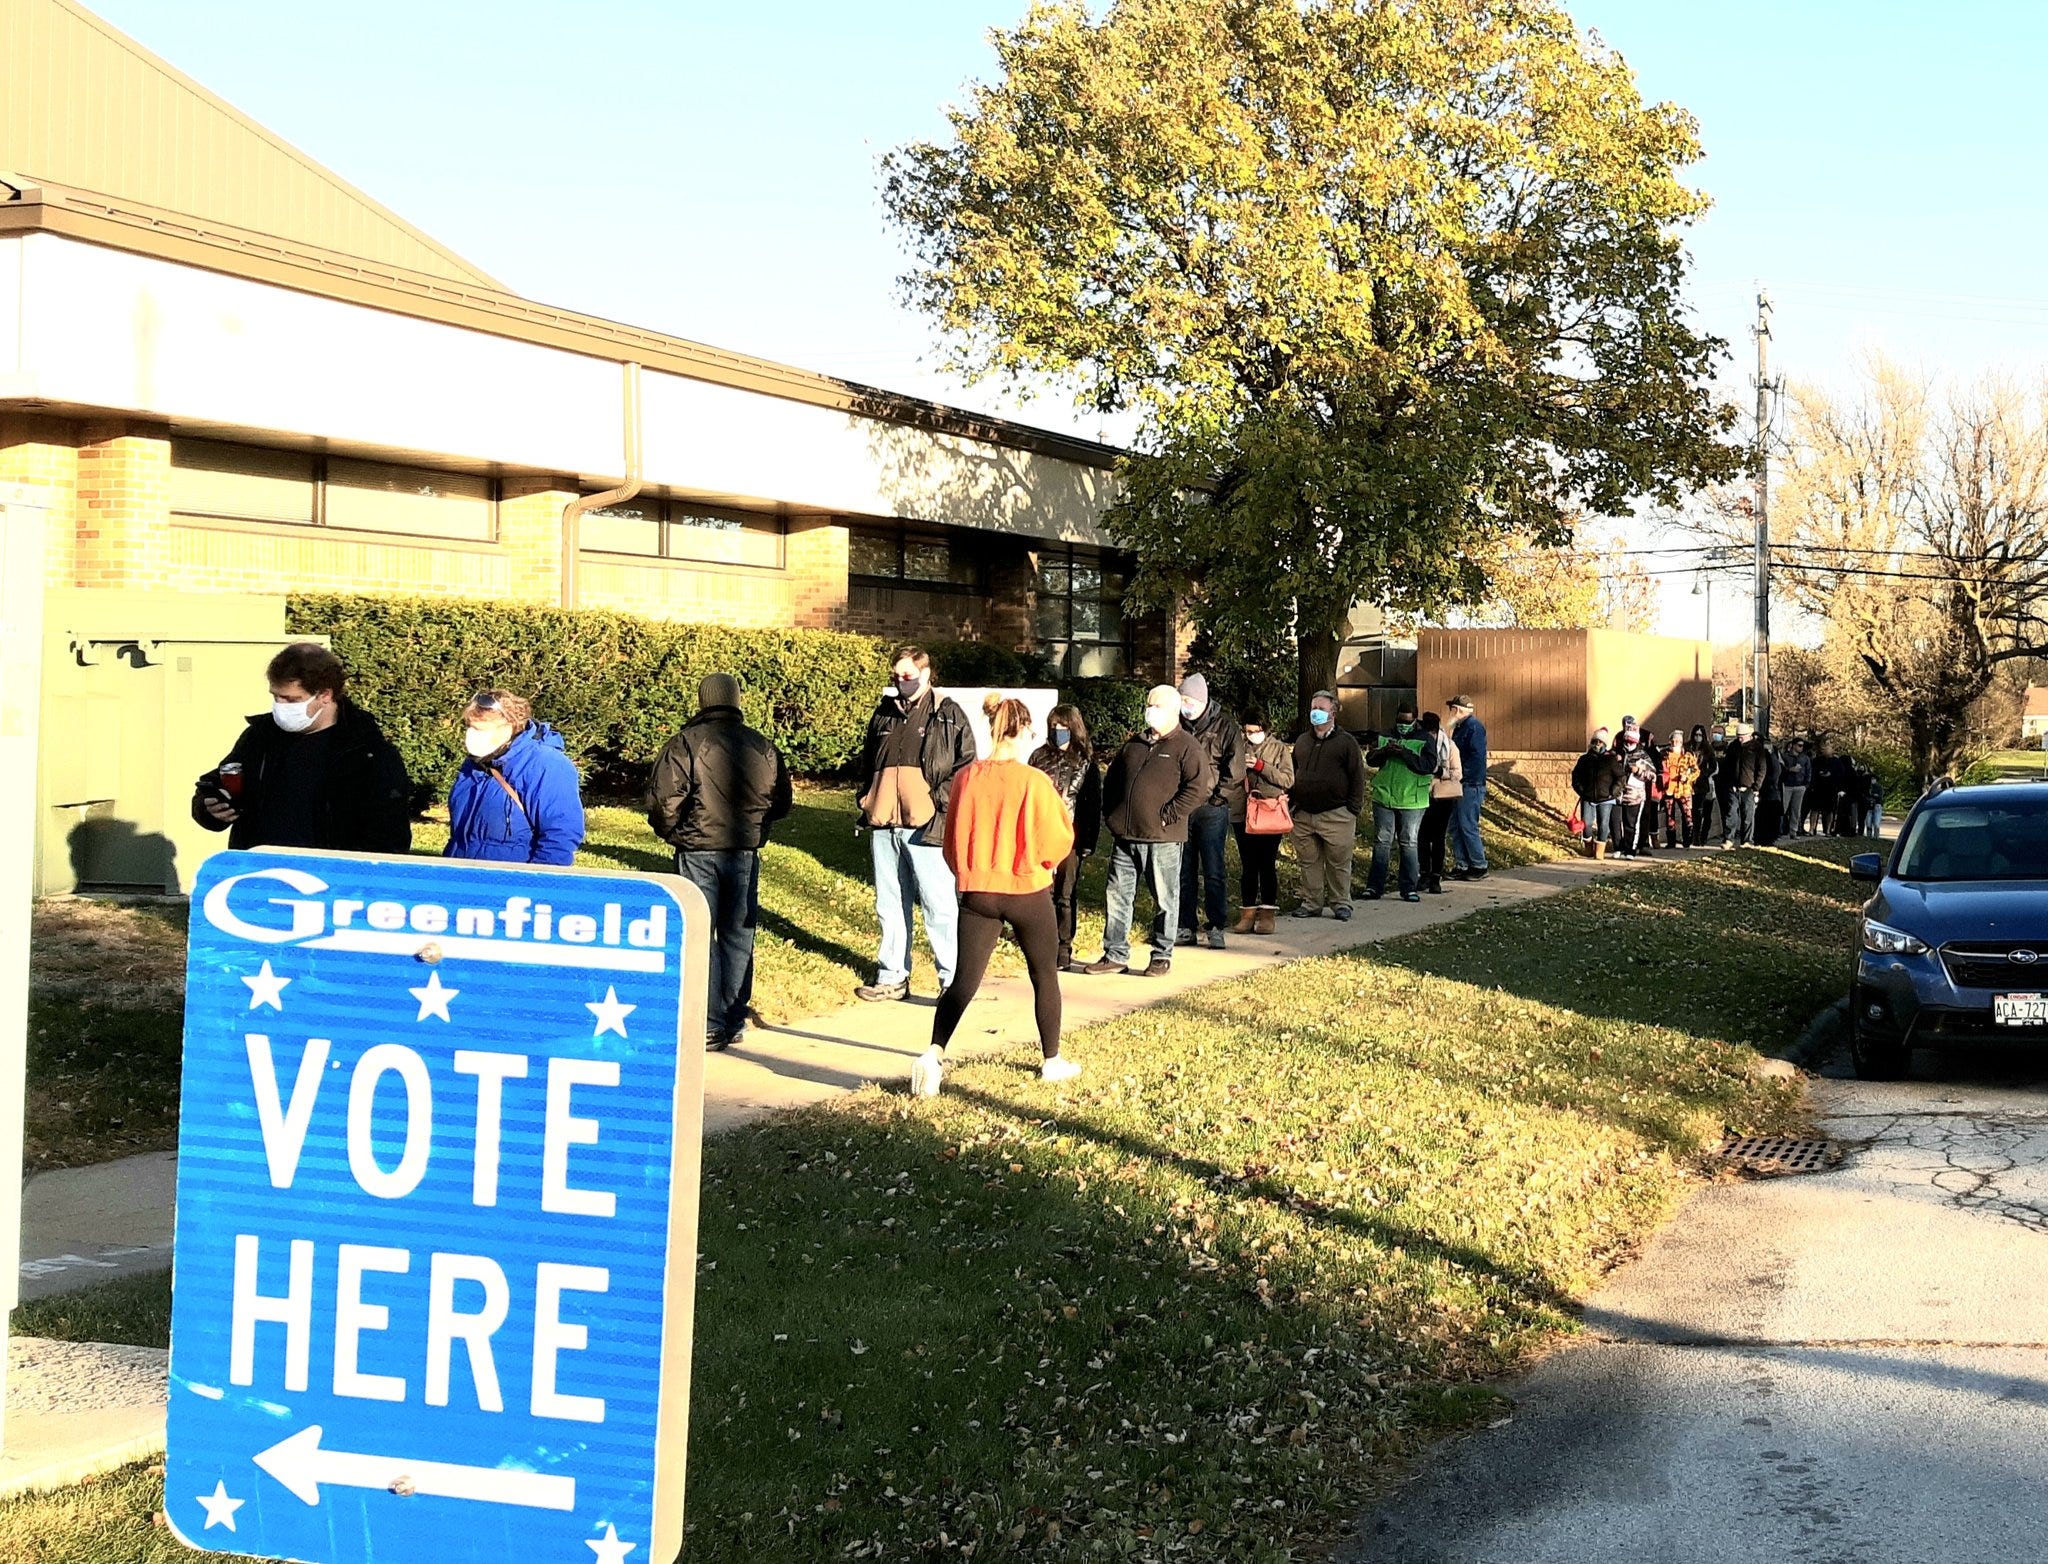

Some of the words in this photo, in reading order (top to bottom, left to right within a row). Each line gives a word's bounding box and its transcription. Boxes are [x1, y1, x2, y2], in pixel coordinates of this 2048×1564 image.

[204, 868, 667, 948] Greenfield
[245, 1034, 621, 1218] VOTE
[230, 1235, 610, 1424] HERE
